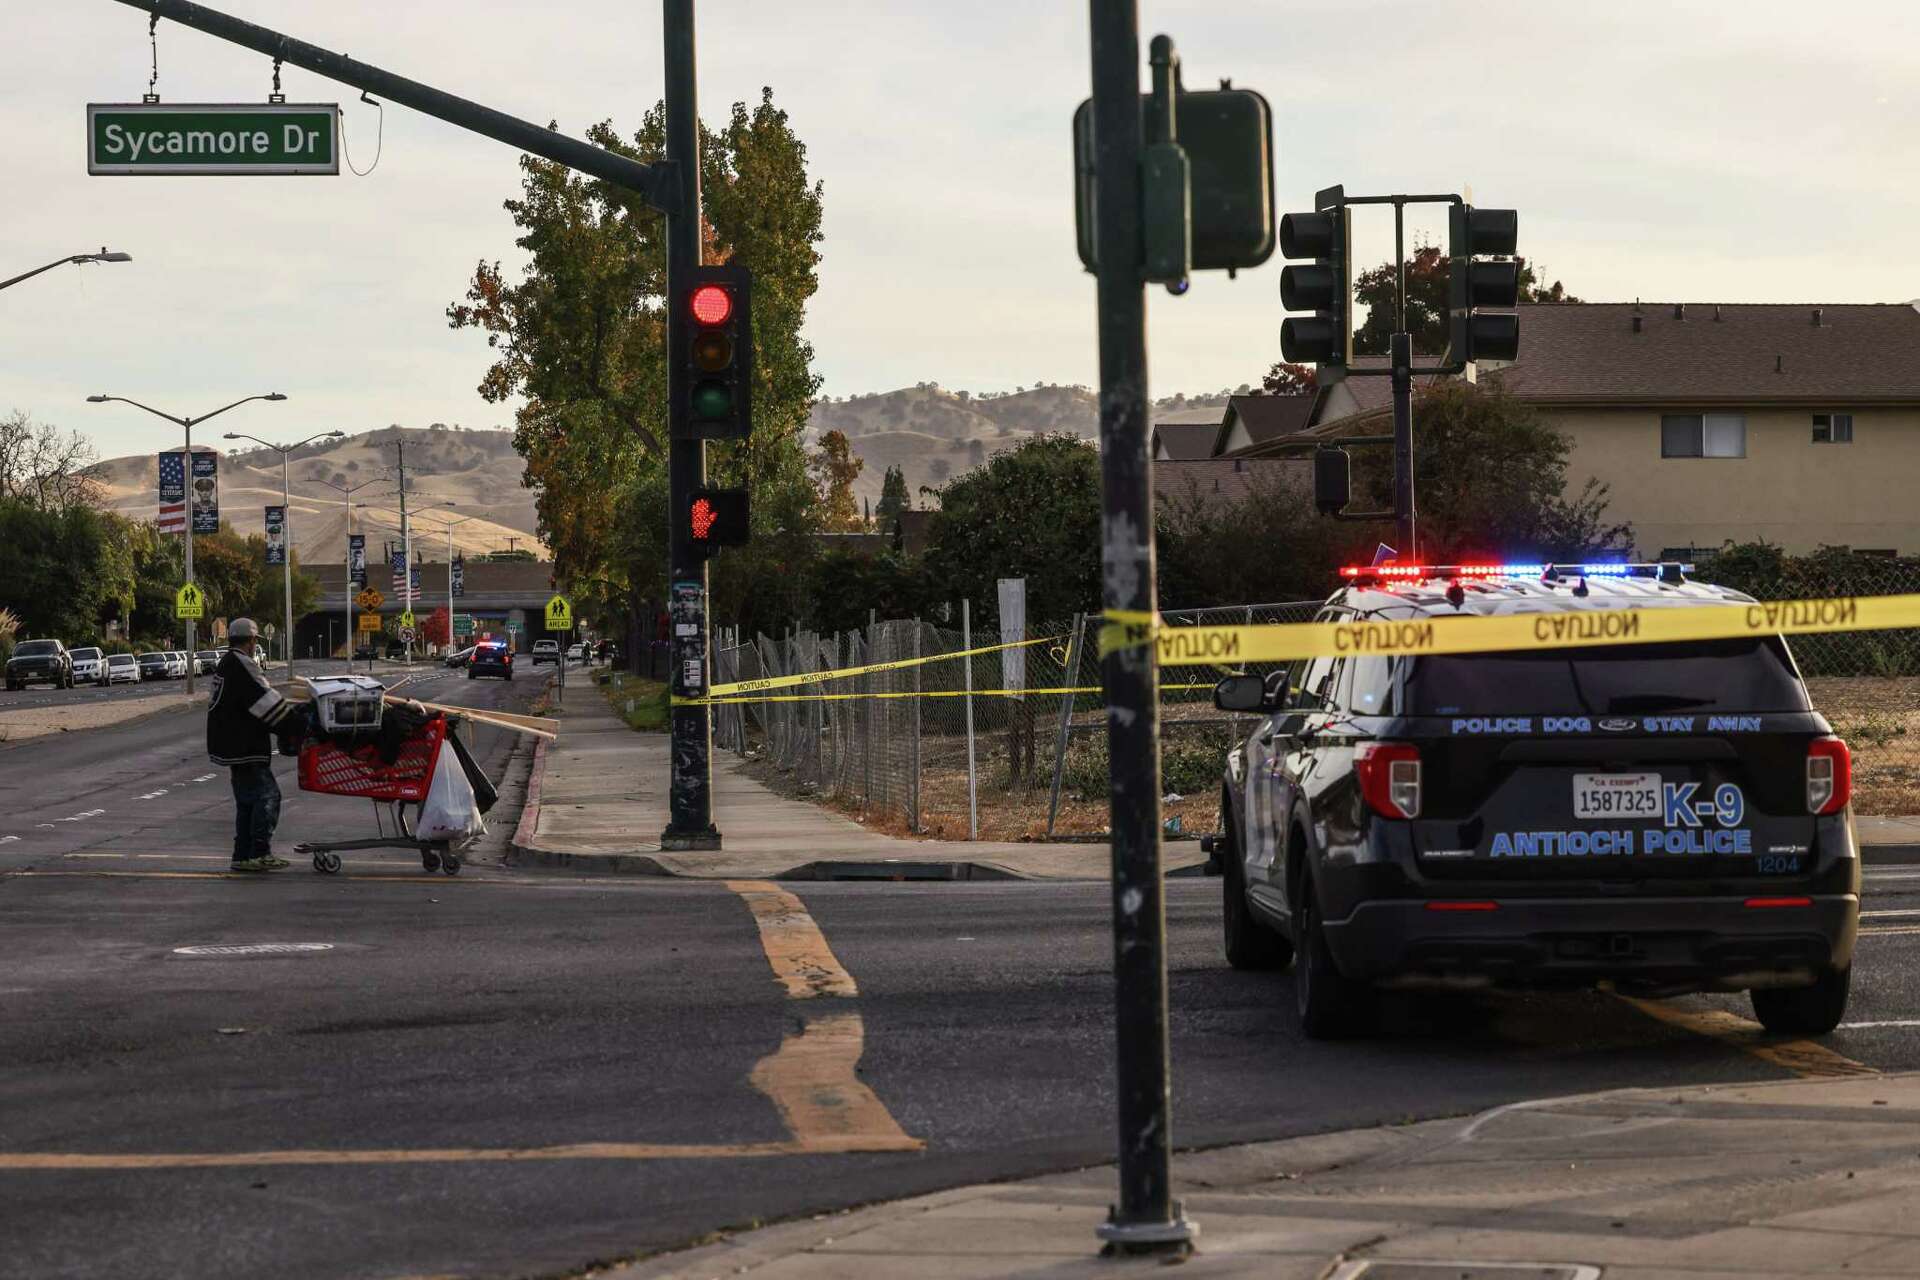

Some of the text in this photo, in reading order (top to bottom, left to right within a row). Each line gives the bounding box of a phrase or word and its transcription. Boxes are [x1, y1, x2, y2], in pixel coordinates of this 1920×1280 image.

[104, 124, 320, 161] Sycamore Dr
[548, 620, 569, 628] AHEAD
[1452, 717, 1591, 734] POLICE DOG
[1643, 717, 1762, 732] STAY AWAY
[1610, 778, 1640, 786] EXEMPT
[1580, 789, 1656, 812] 1587325
[1663, 782, 1744, 828] K-9
[1490, 829, 1753, 857] ANTIOCH POLICE
[1757, 857, 1799, 873] 1204
